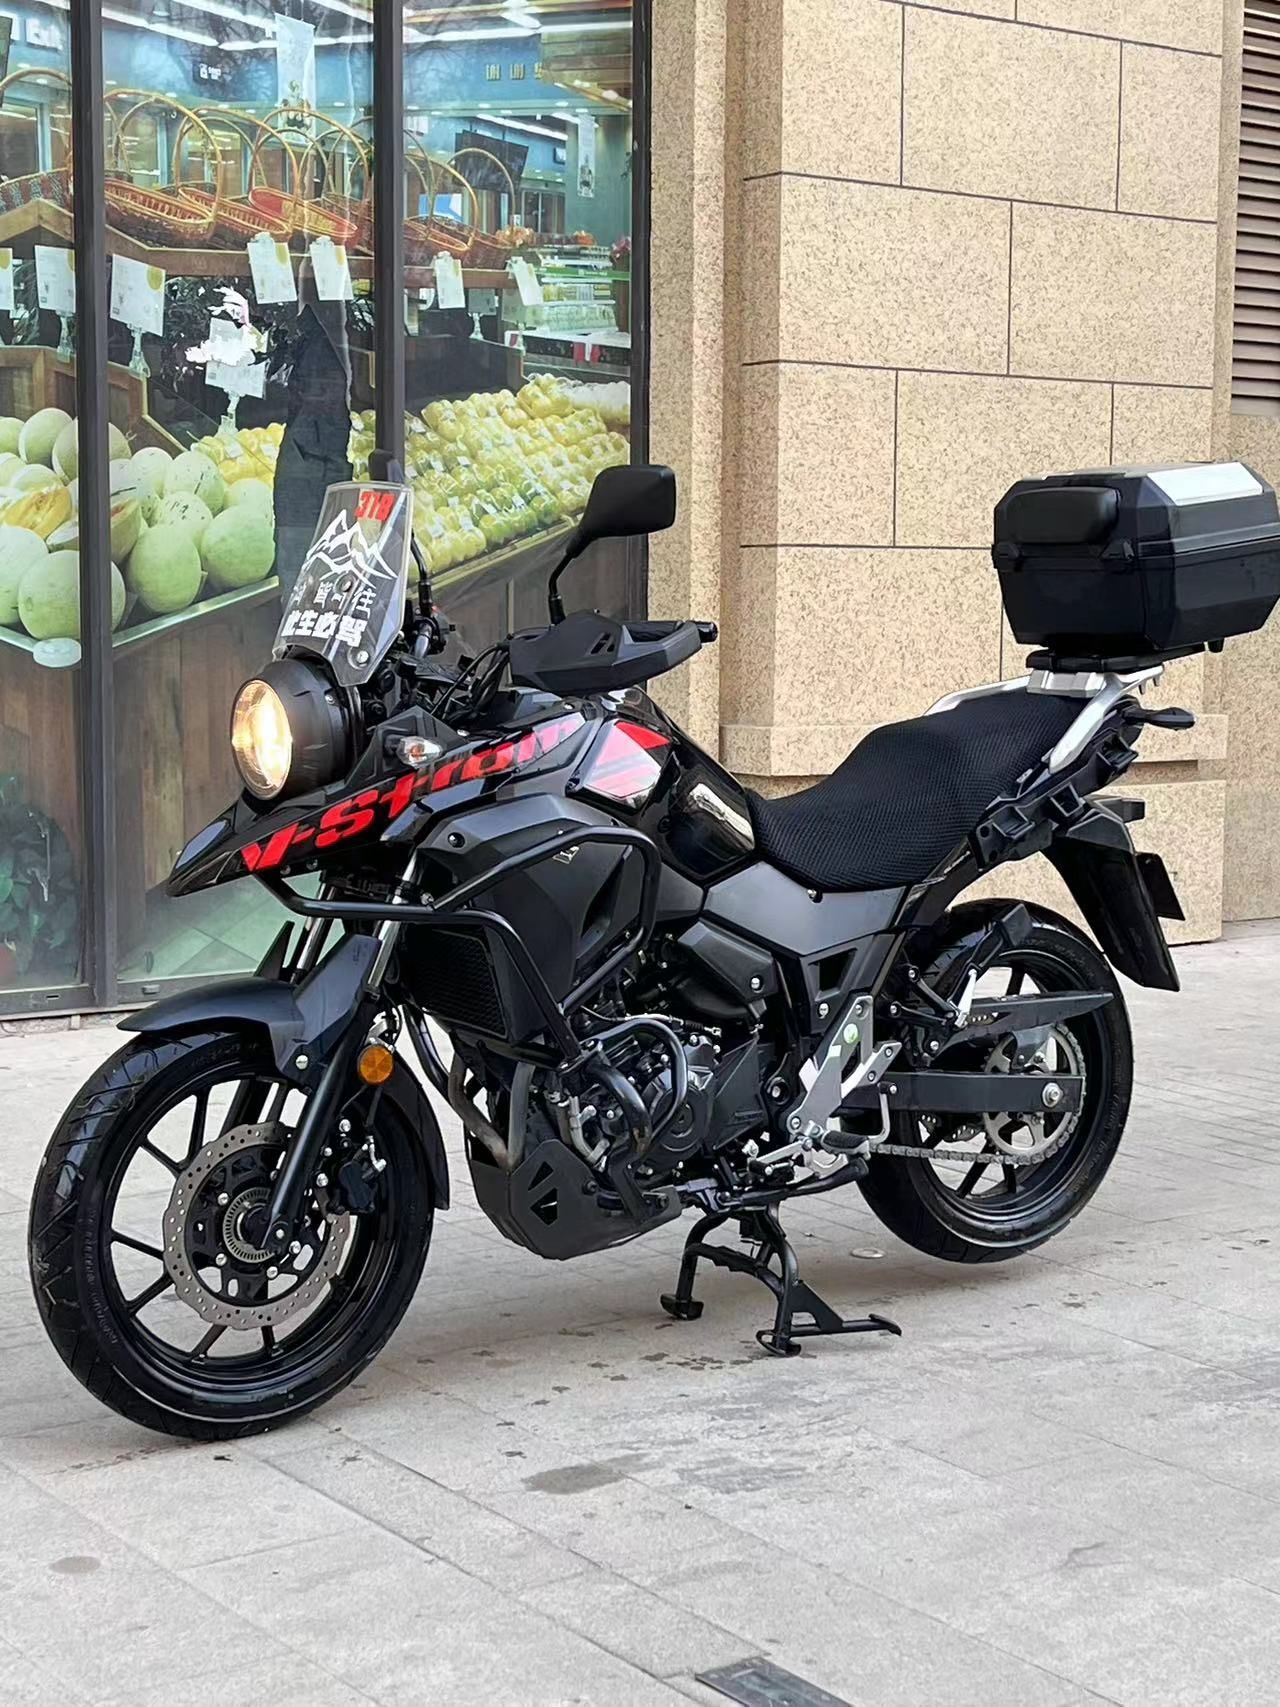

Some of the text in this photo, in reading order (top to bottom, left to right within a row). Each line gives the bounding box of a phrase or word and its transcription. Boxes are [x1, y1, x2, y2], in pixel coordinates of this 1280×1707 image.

[355, 491, 395, 521] 318
[281, 610, 367, 647] 此生必驾
[240, 718, 584, 871] V-Strom
